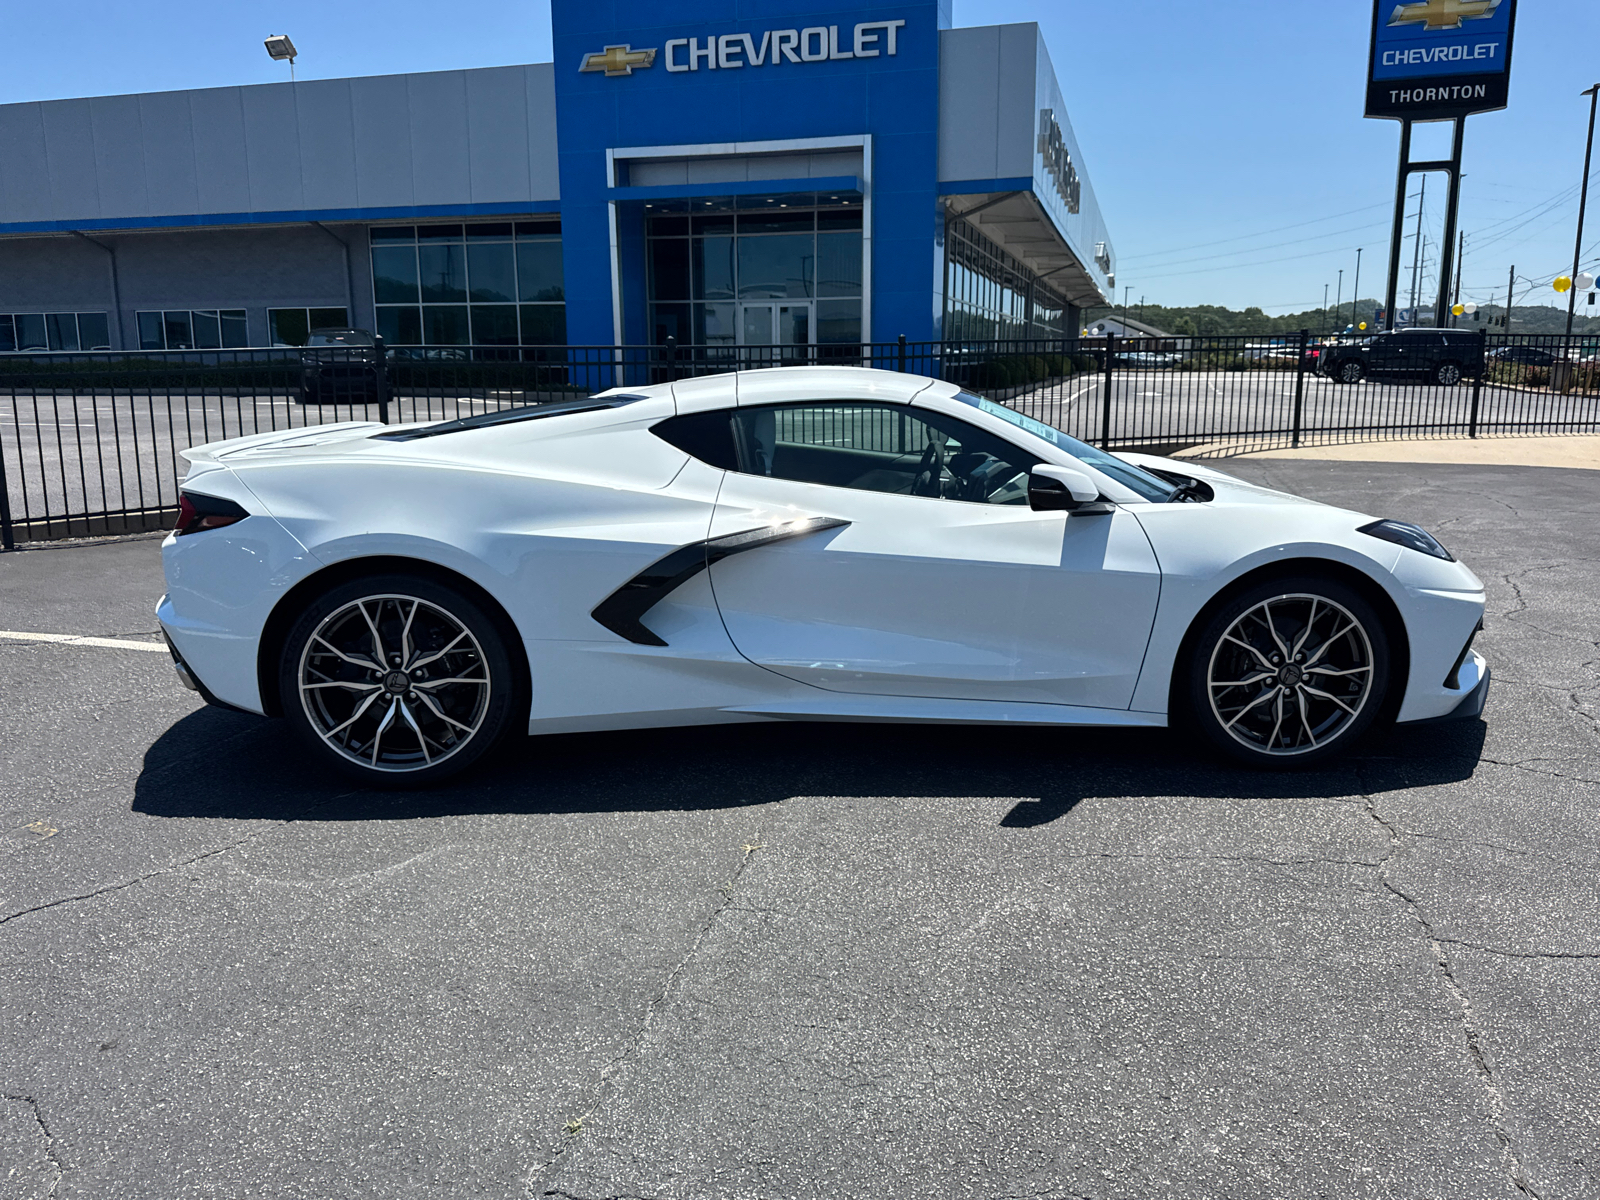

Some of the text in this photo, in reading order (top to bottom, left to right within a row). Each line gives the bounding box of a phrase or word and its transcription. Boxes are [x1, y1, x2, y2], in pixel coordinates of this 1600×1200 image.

[665, 19, 906, 72] CHEVROLET
[1382, 43, 1499, 66] CHEVROLET
[1389, 85, 1486, 103] THORNTON
